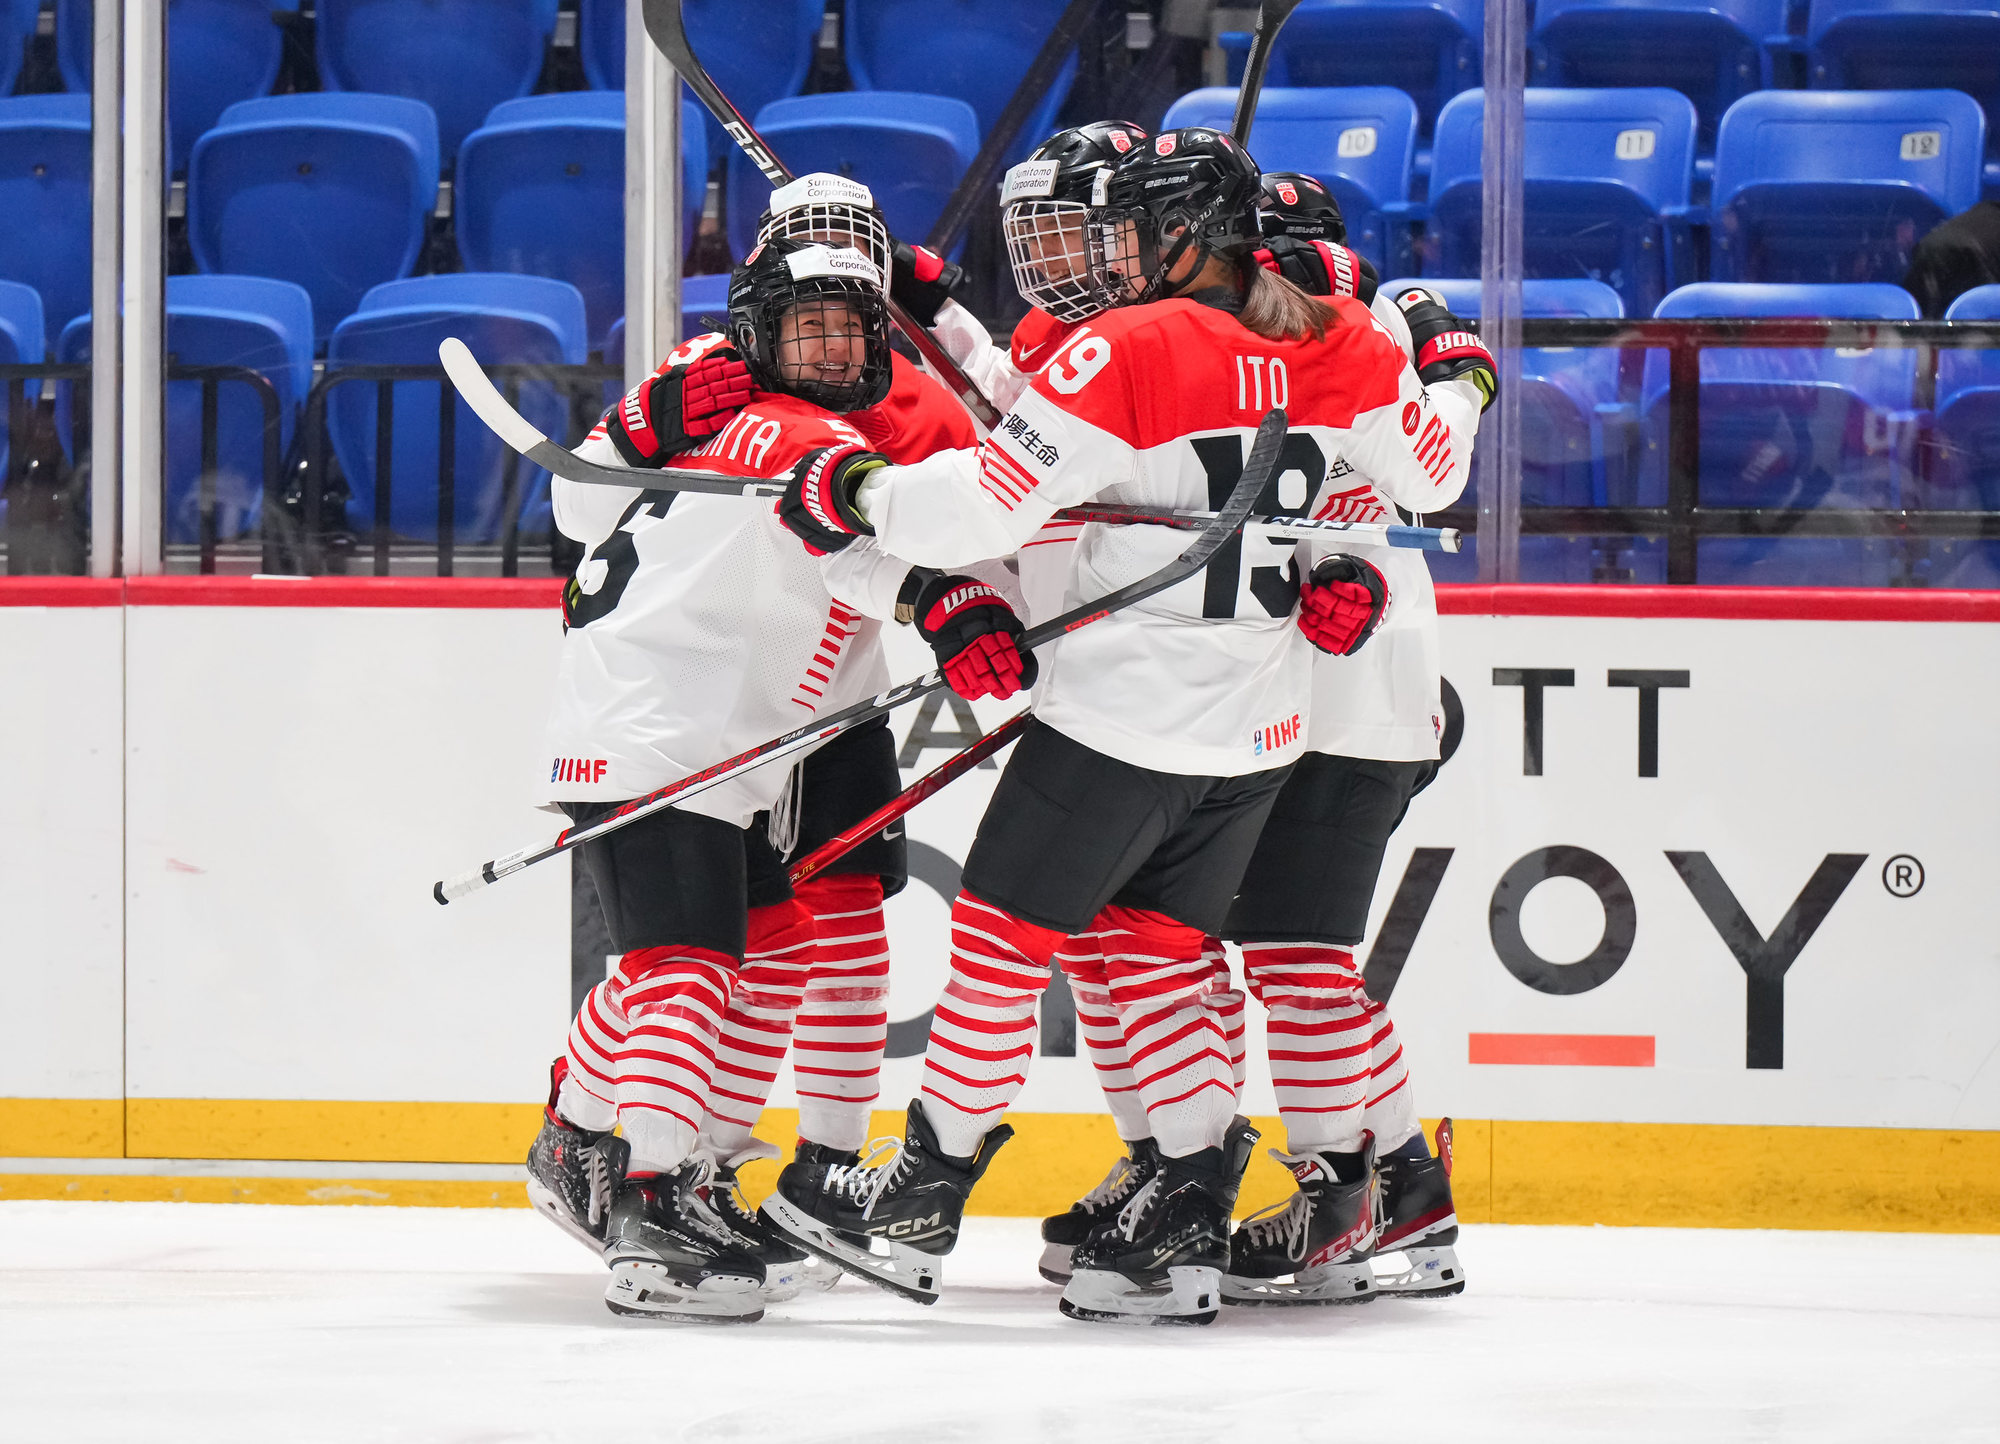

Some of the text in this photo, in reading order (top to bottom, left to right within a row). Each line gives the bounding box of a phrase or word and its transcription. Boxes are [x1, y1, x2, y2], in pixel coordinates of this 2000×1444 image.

[1626, 135, 1645, 153] 11
[1012, 178, 1049, 191] Corporation
[1015, 167, 1052, 179] Sumitomo
[807, 188, 867, 201] Corporation
[1037, 326, 1111, 395] 19
[1236, 355, 1289, 411] ITO
[1190, 432, 1326, 618] 19
[1265, 713, 1302, 752] IIHF
[558, 757, 608, 784] IIHF
[603, 747, 761, 824] JETSPEED
[778, 728, 806, 745] TEAM
[864, 1211, 941, 1237] CCM
[1306, 1219, 1368, 1269] CCM
